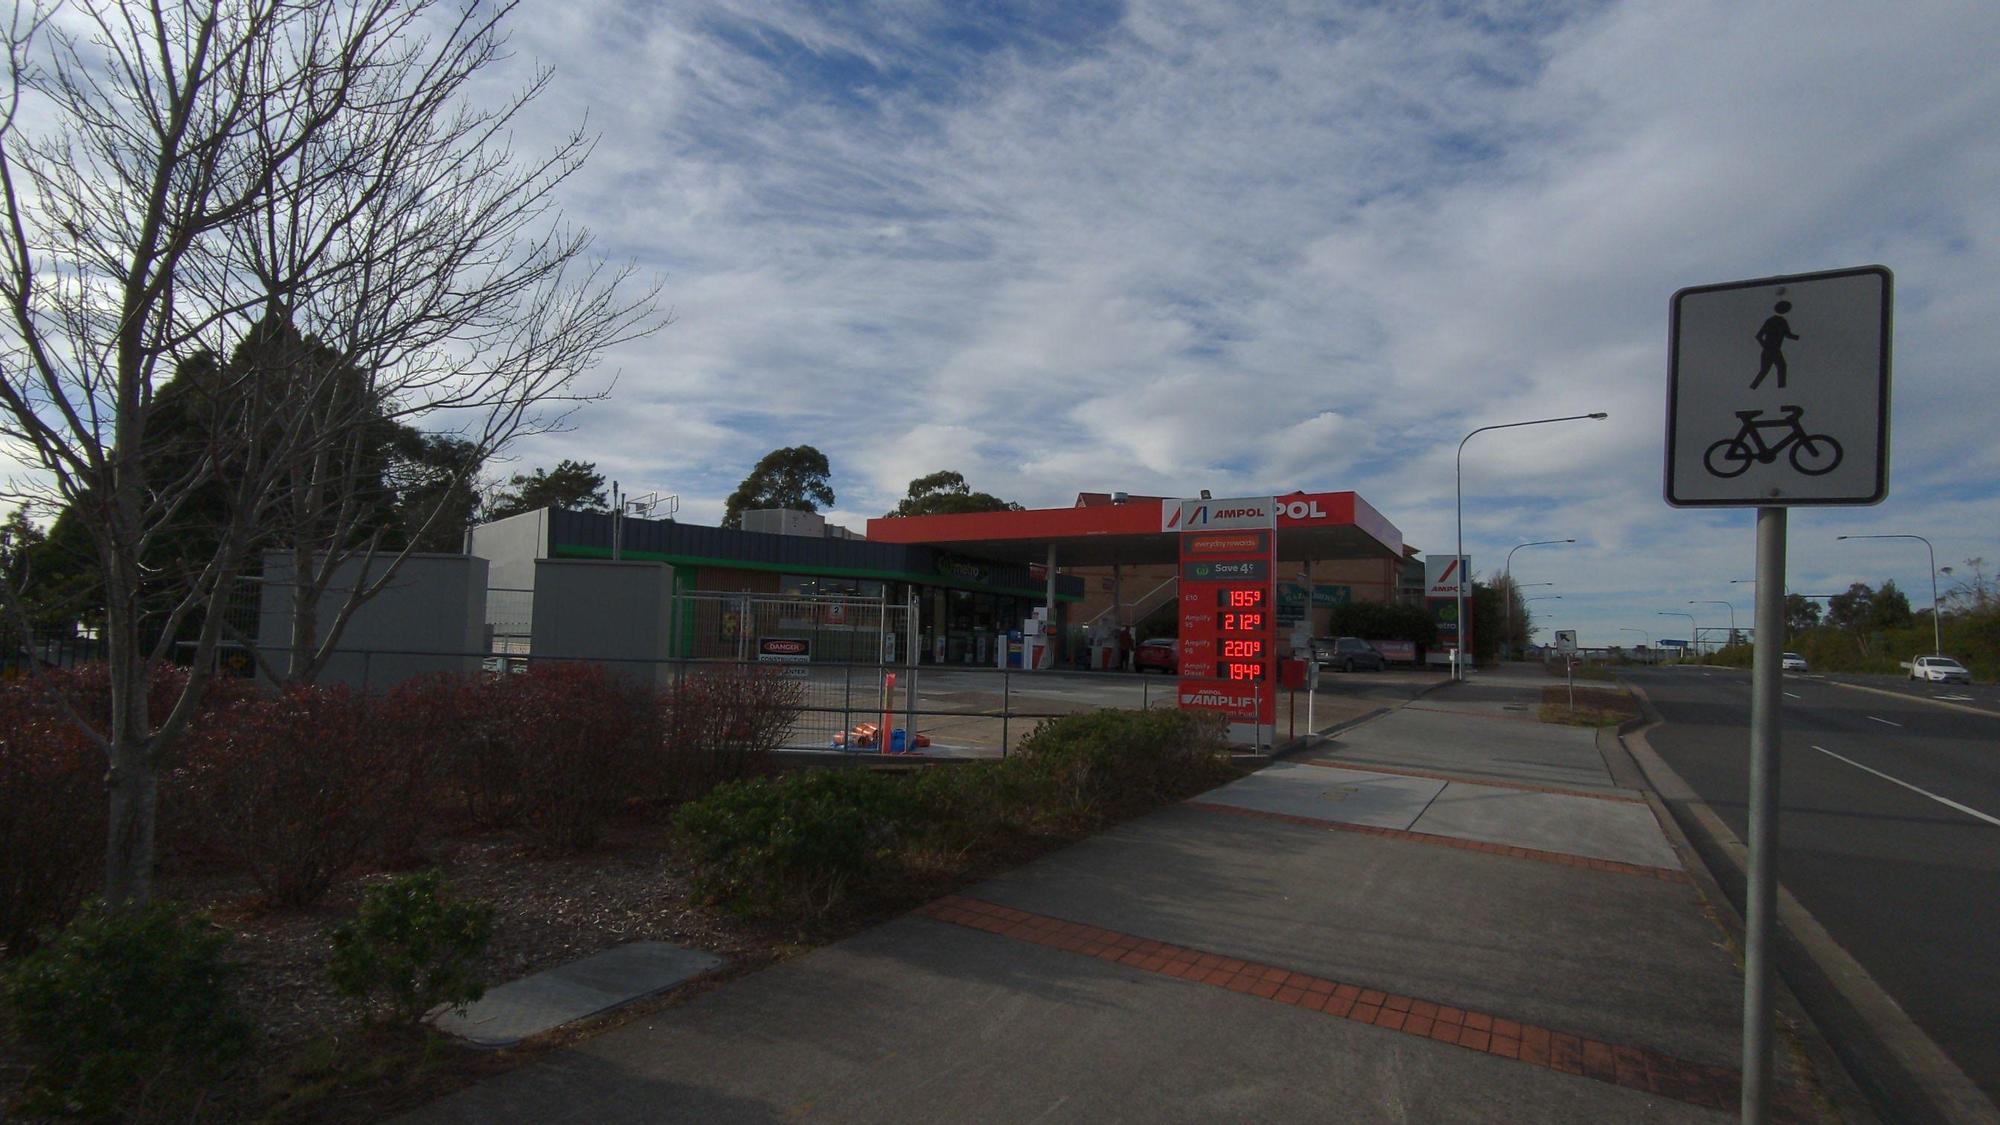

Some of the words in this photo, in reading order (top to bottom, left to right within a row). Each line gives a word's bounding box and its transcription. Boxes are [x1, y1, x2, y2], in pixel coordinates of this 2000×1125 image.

[1214, 508, 1264, 519] AMPOL
[1276, 501, 1326, 519] POL
[1215, 564, 1238, 573] Save
[769, 643, 800, 652] DANGER
[1191, 695, 1263, 708] AMPLIFY
